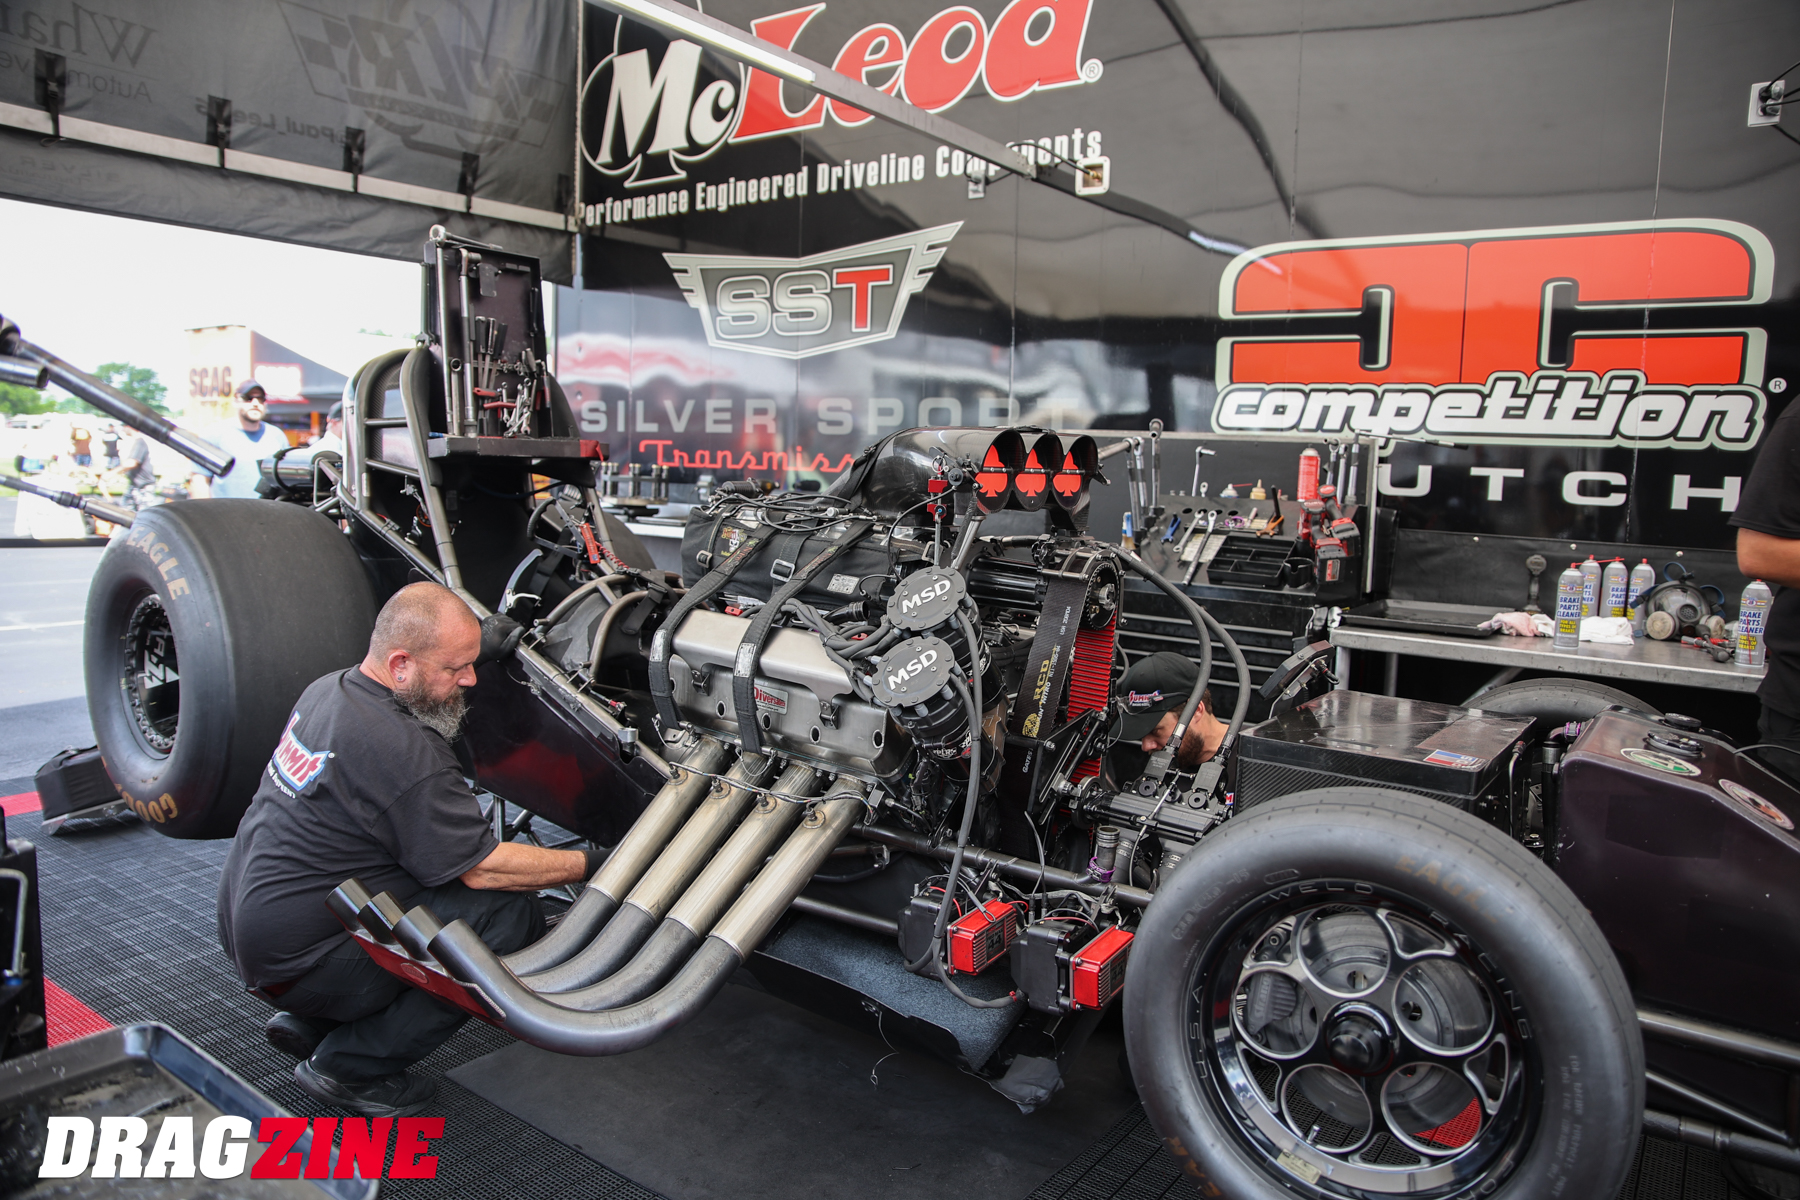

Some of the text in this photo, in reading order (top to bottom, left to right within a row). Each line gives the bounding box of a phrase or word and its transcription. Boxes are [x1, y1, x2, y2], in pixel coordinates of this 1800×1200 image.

[695, 165, 808, 212] Engineered
[816, 150, 924, 195] Driveline
[935, 127, 1102, 177] Comnents
[716, 263, 894, 339] SST
[189, 366, 232, 398] SCAG
[580, 398, 777, 434] SILVER
[1218, 377, 1752, 444] competition
[638, 438, 854, 473] Transmiss
[1376, 462, 1742, 512] UTCH
[126, 525, 190, 601] EAGLE
[902, 579, 951, 614] MSD
[1556, 610, 1581, 618] CLEANER
[1559, 603, 1580, 611] PARTS
[1740, 611, 1763, 619] BRAKE
[1739, 619, 1761, 627] PARTS
[887, 648, 938, 691] MSD
[1033, 659, 1050, 701] RCD
[1269, 880, 1532, 1041] WELD RACING
